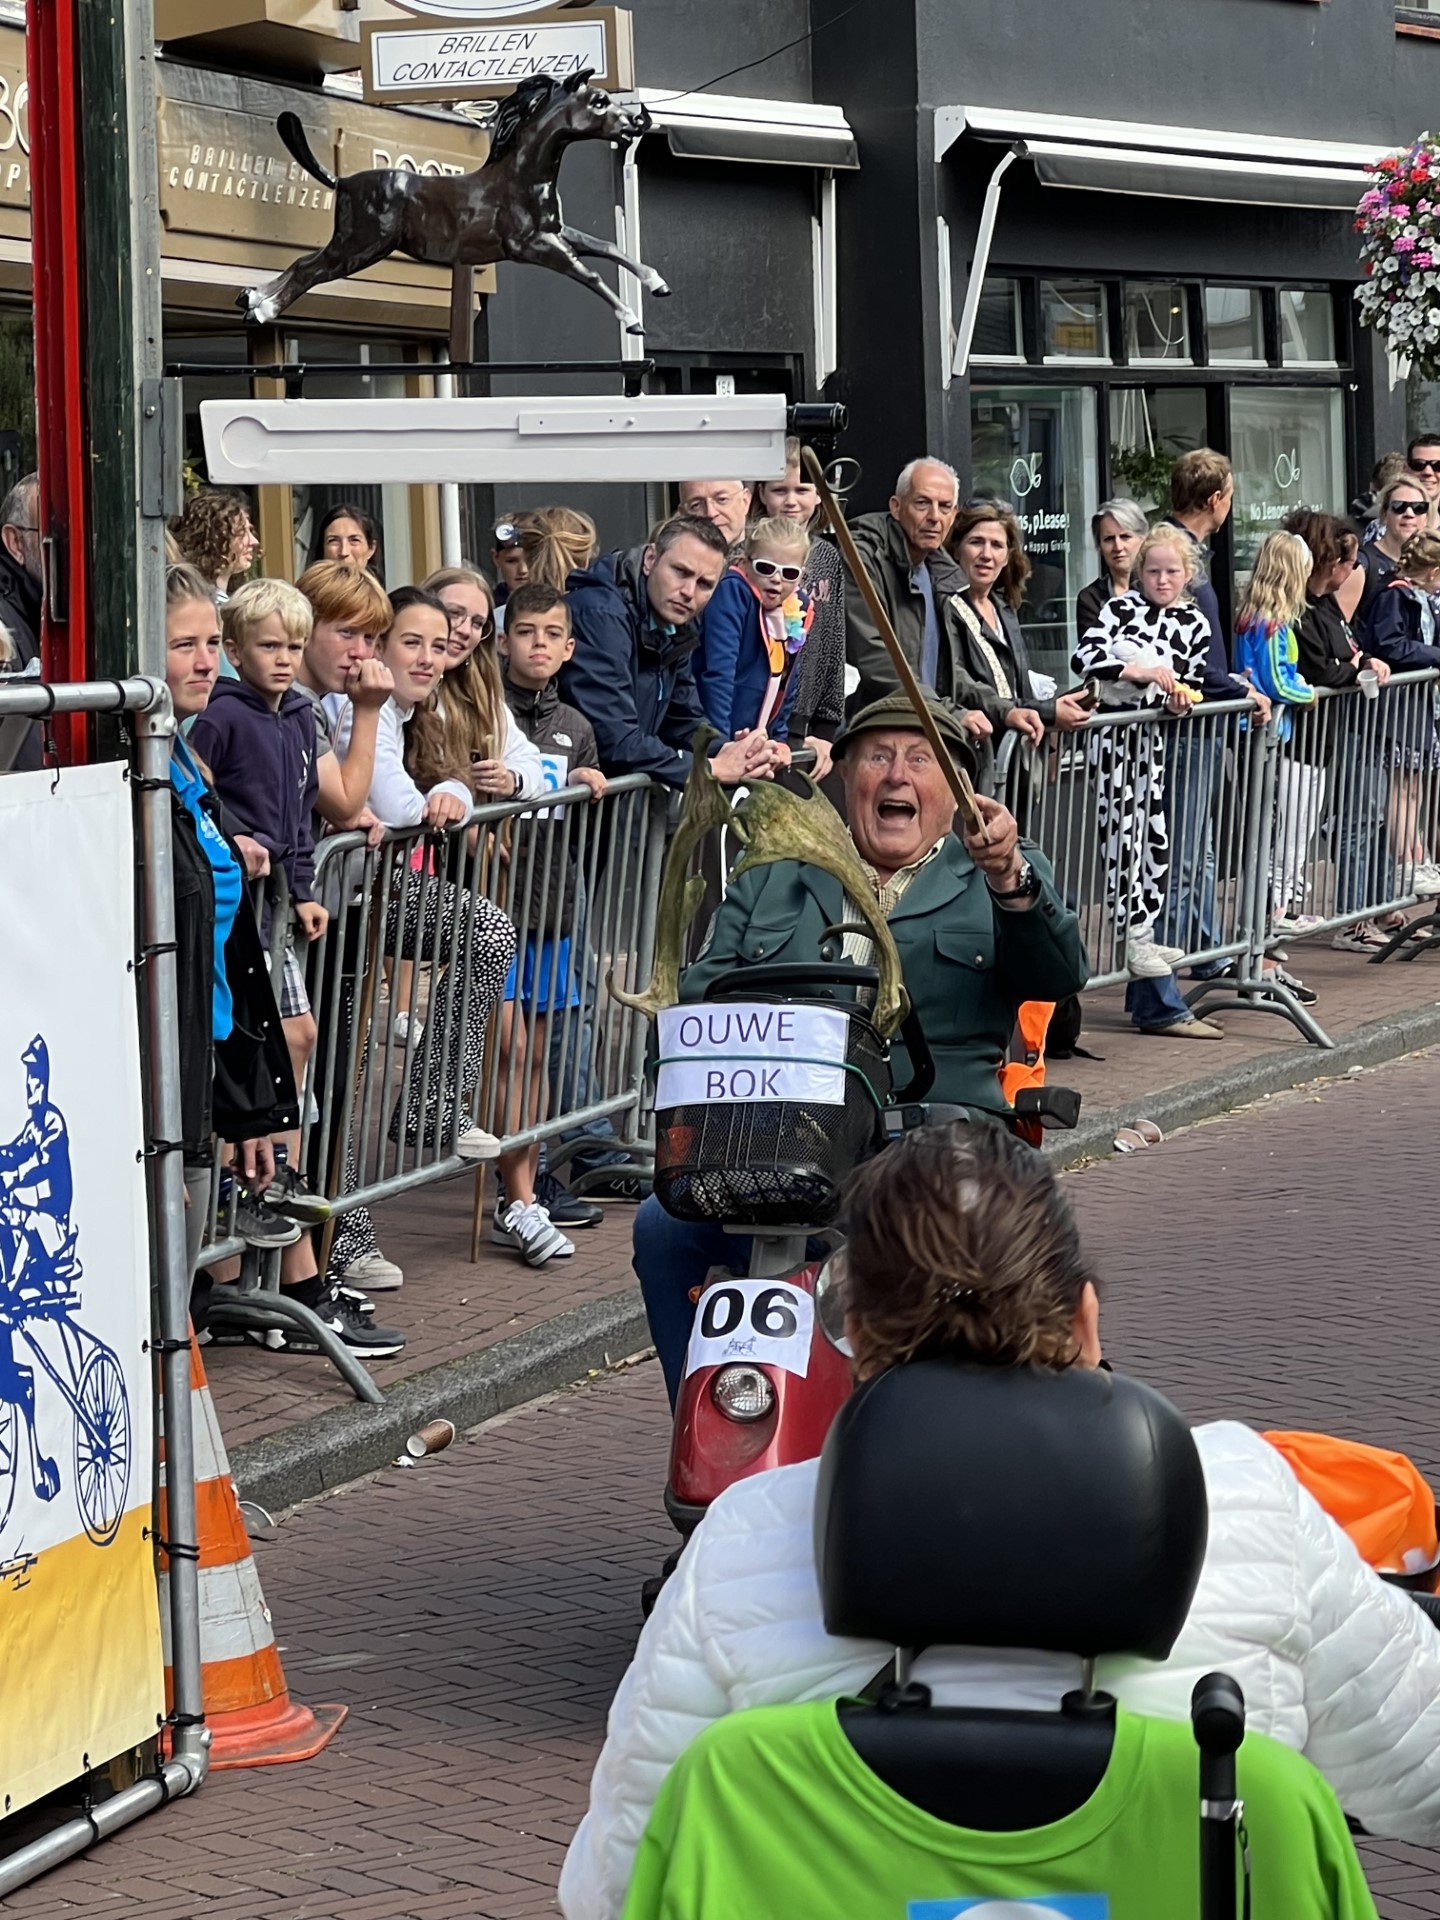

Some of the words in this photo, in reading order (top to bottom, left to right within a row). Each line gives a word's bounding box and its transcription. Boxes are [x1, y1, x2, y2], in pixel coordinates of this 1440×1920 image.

[438, 33, 537, 55] BRILLEN
[393, 54, 588, 82] CONTACTLENZEN
[190, 144, 275, 176] BRILLEN
[169, 166, 334, 210] CONTACTLENZEN
[1033, 509, 1070, 536] please!
[679, 1011, 795, 1047] OUWE
[706, 1068, 781, 1099] BOK
[700, 1287, 799, 1339] 06
